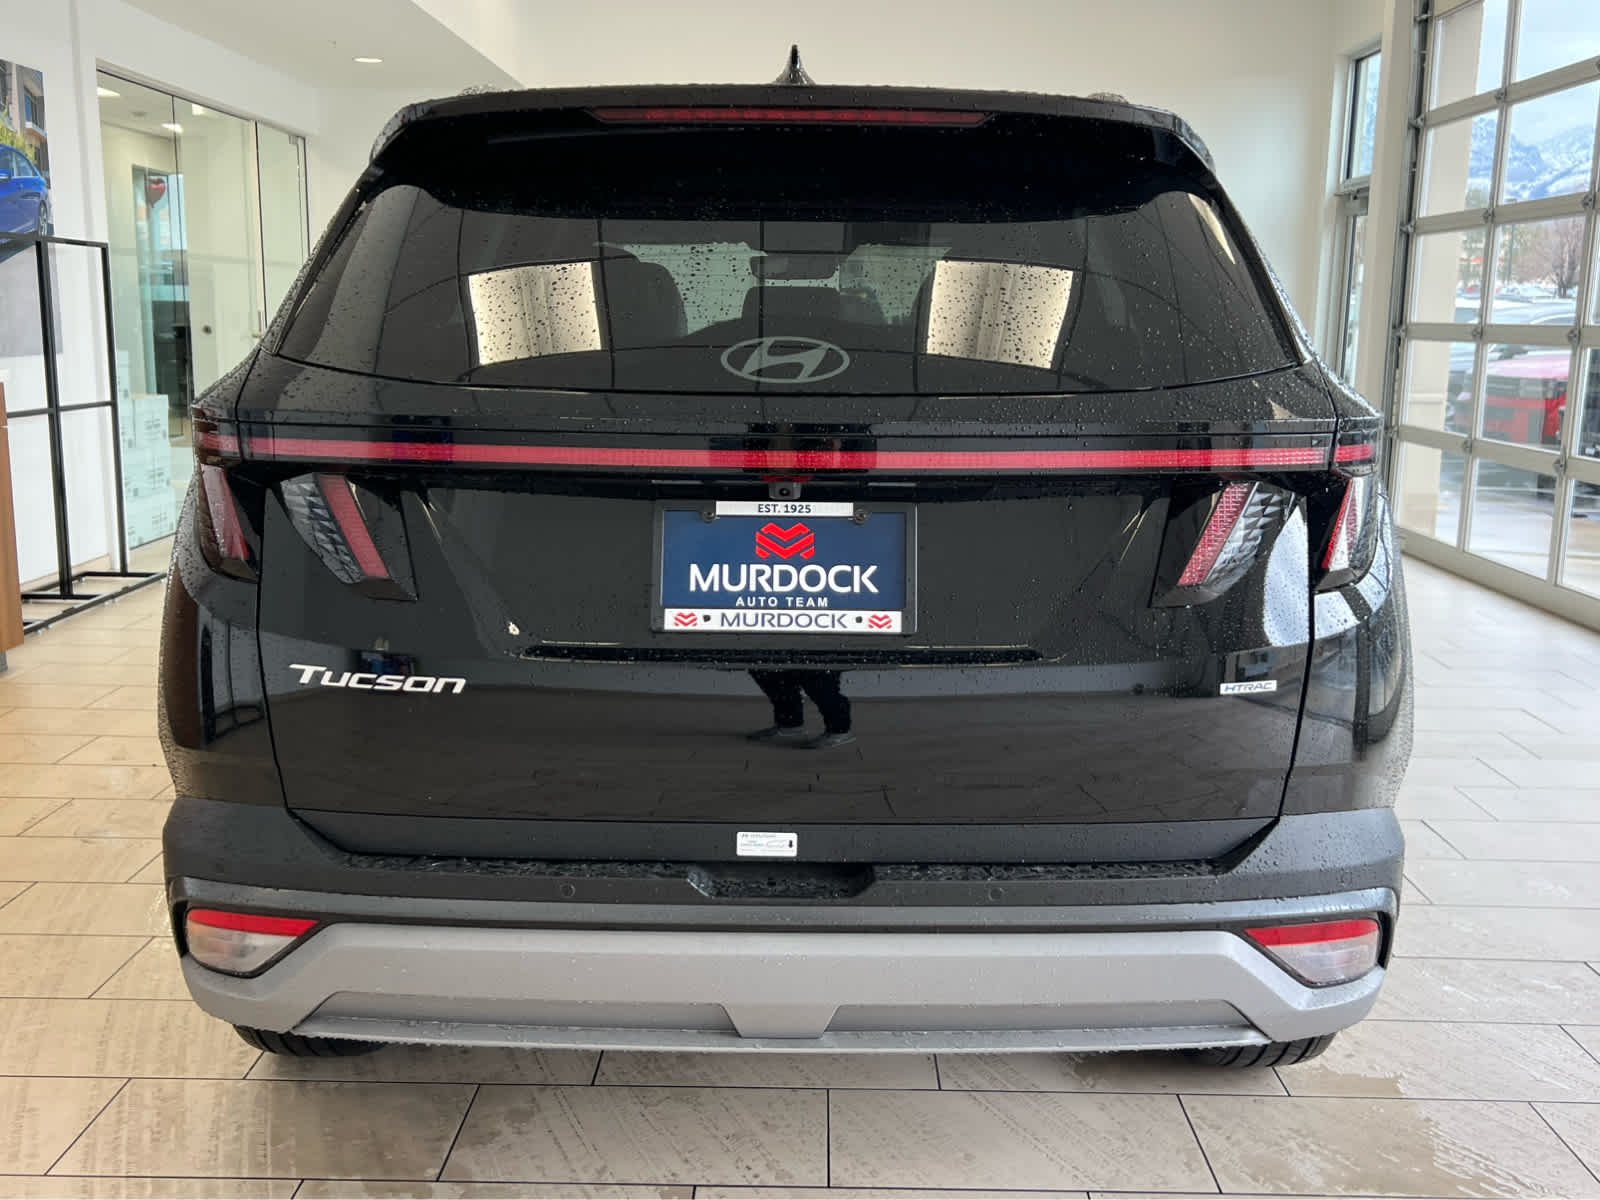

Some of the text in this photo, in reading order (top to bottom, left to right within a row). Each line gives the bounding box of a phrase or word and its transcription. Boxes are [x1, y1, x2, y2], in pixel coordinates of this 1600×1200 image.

[757, 503, 812, 514] EST. 1925
[689, 563, 879, 593] MURDOCK
[735, 596, 829, 608] AUTO TEAM
[720, 612, 848, 629] MURDOCK
[1224, 682, 1273, 692] HTRAC
